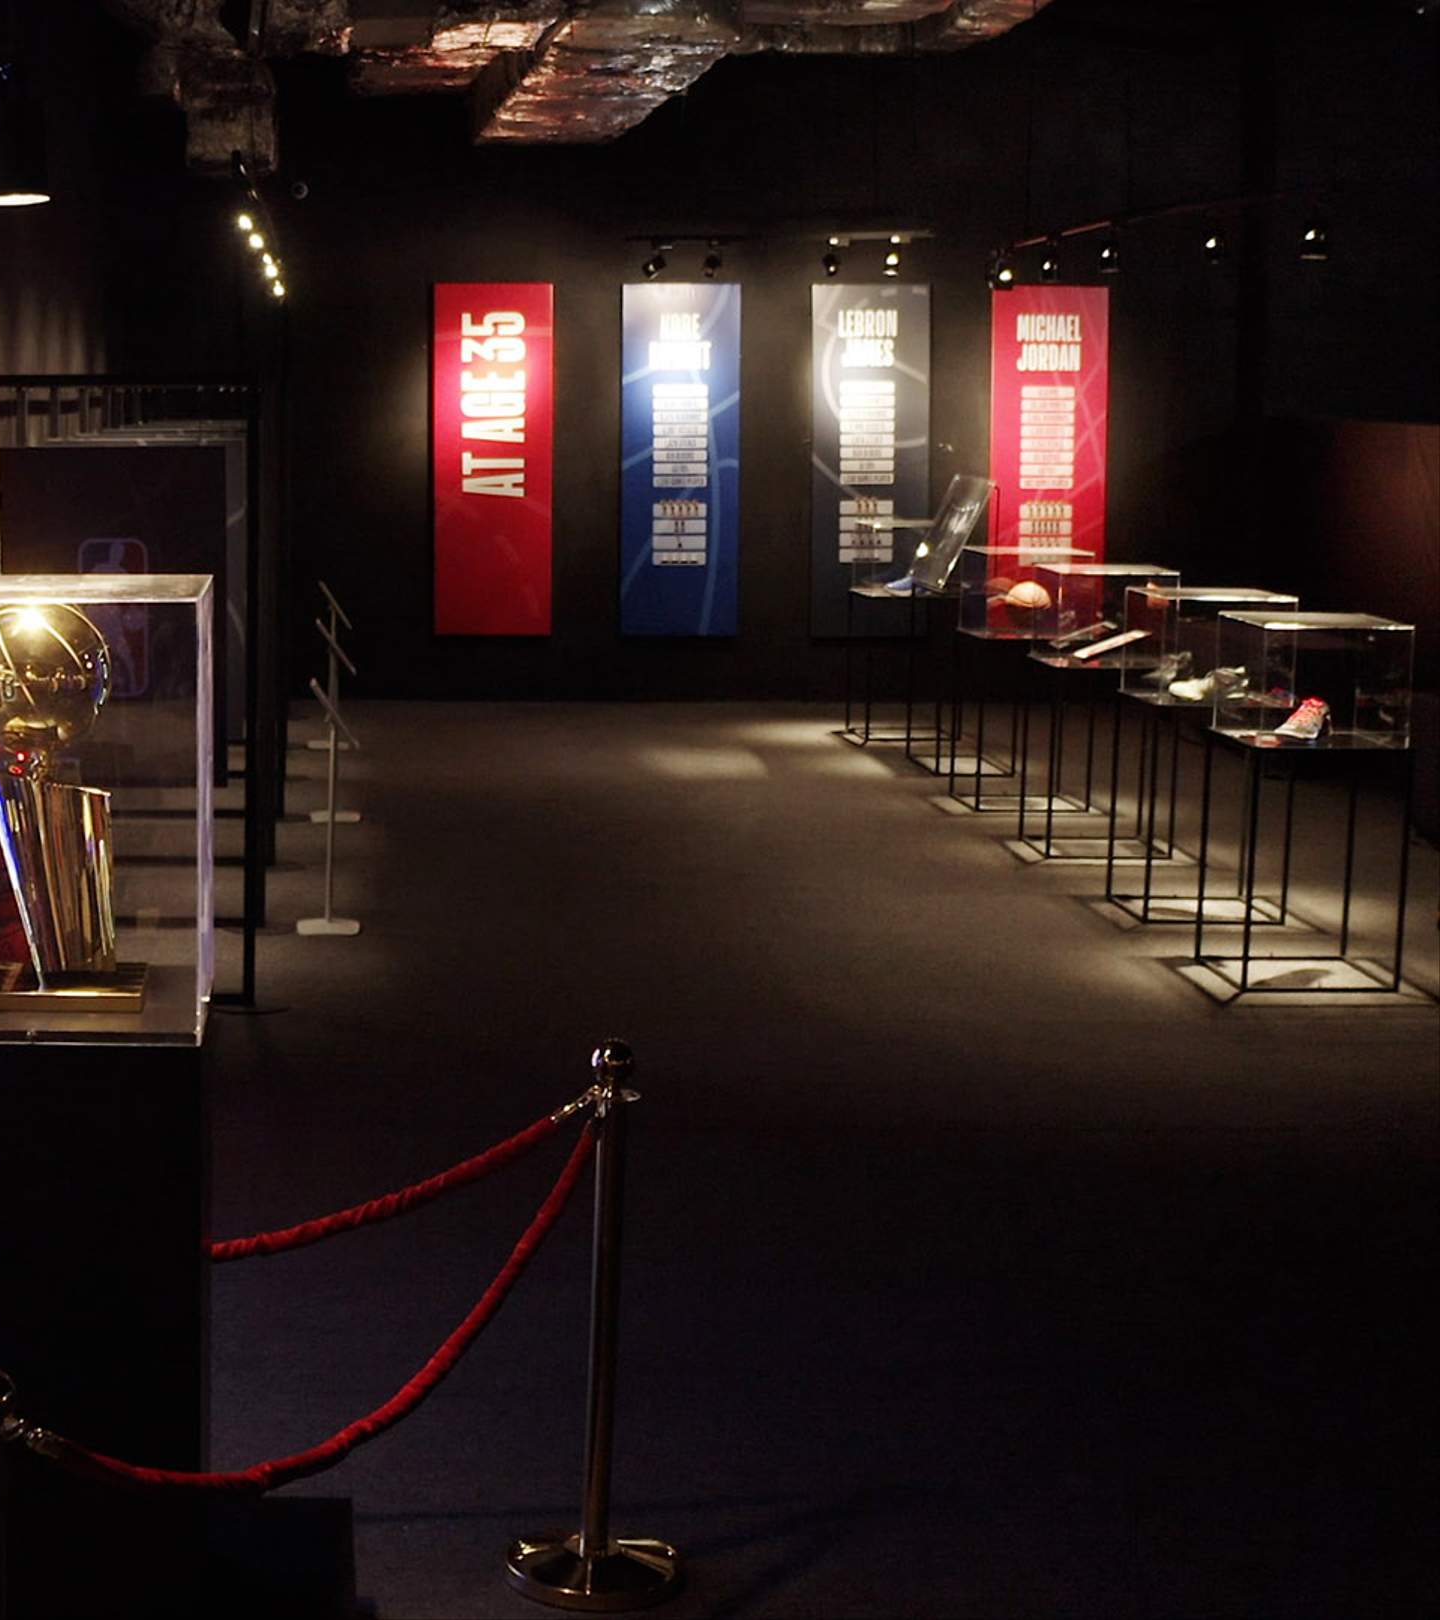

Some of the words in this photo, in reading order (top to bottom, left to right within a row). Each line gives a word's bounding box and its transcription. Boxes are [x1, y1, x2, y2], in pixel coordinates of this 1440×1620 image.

[461, 311, 527, 363] 35
[838, 309, 899, 337] LEBRON
[1016, 314, 1082, 342] MICHAEL
[1016, 344, 1081, 372] JORDAN
[461, 370, 527, 443] AGE
[462, 452, 526, 498] AT
